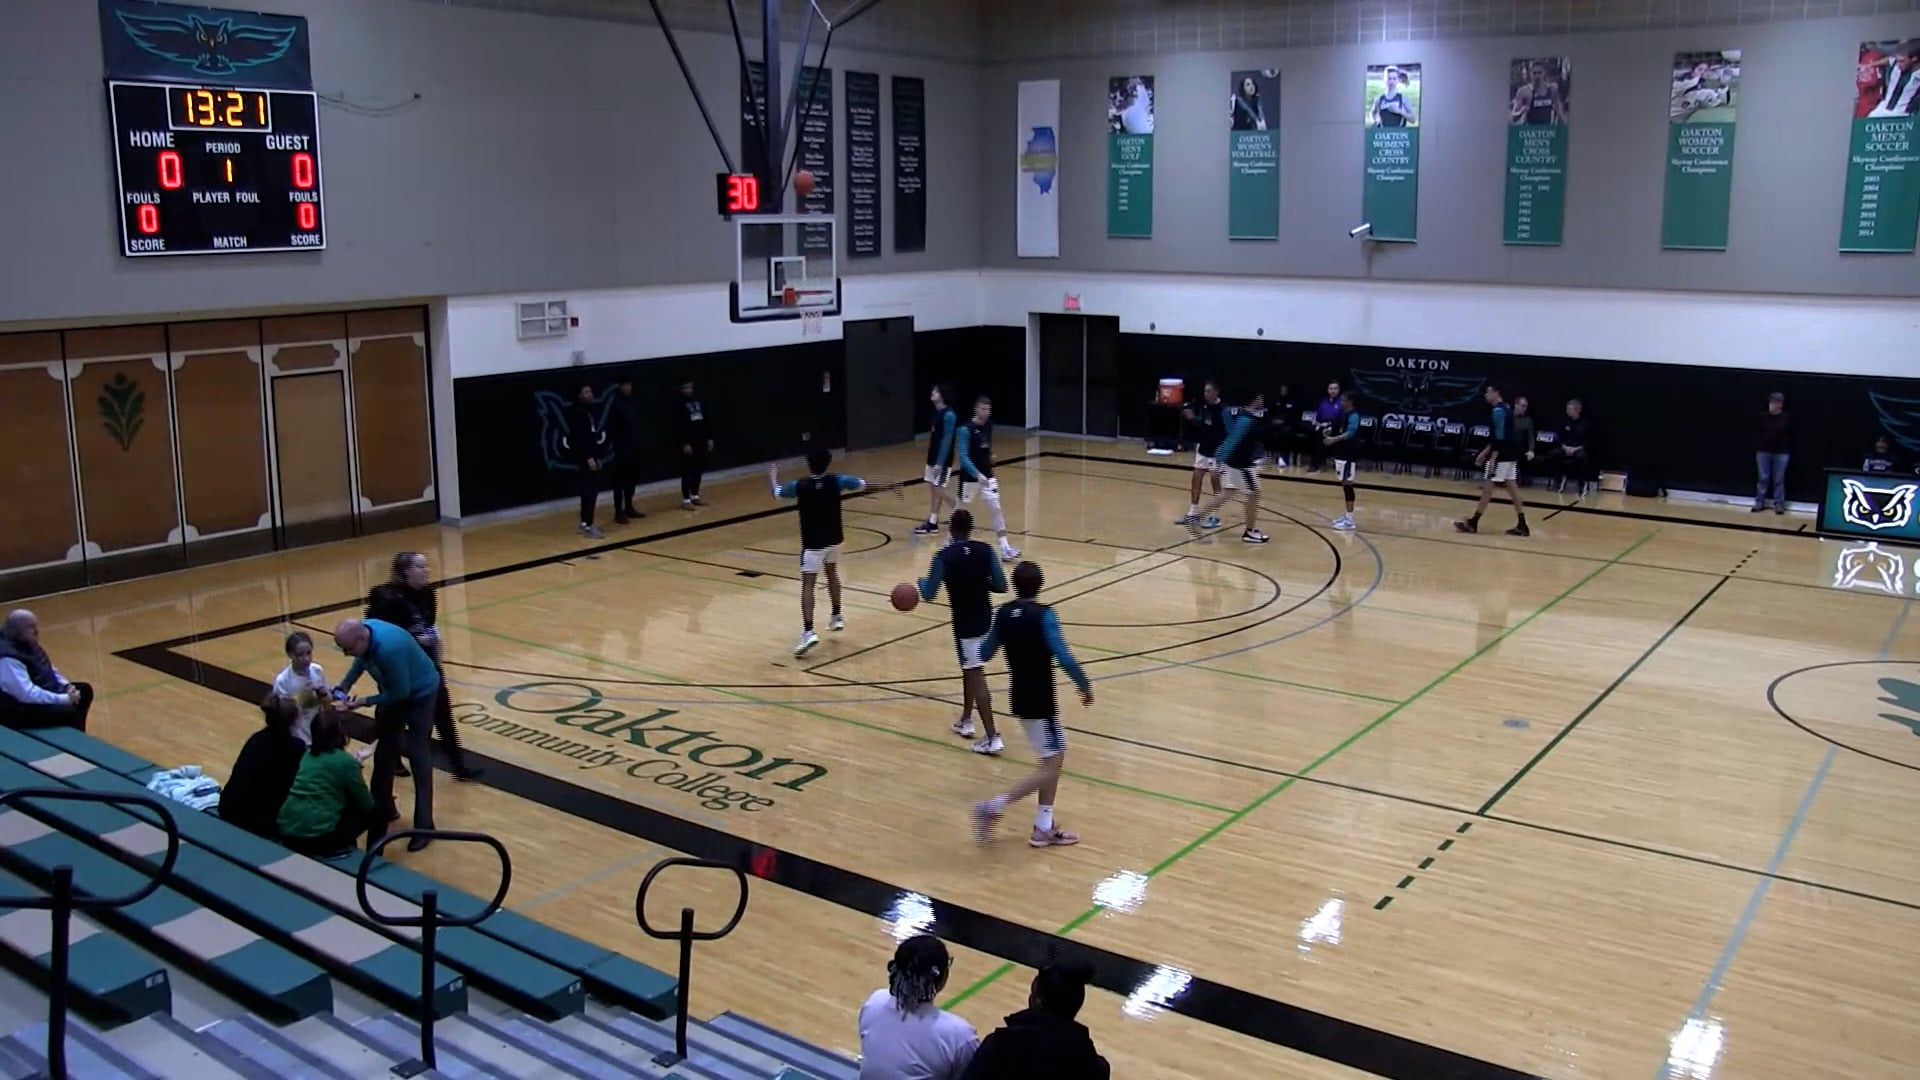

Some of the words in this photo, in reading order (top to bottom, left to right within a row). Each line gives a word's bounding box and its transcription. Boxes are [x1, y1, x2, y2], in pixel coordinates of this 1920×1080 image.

[185, 90, 265, 126] 13:21
[1681, 128, 1722, 137] OAKTON
[1865, 121, 1914, 132] OAKTON
[129, 131, 175, 148] HOME
[1239, 135, 1270, 143] OAKTON
[1374, 132, 1409, 140] OAKTON
[1519, 130, 1556, 138] OAKTON
[1871, 132, 1906, 142] MEN'S
[265, 135, 310, 151] GUEST
[1523, 139, 1550, 147] MEN'S
[1678, 137, 1724, 145] WOMEN'S
[1865, 142, 1910, 152] SOCCER
[205, 142, 241, 154] PERIOD
[1231, 150, 1277, 158] VOLLEYBALL
[1681, 146, 1720, 155] SOCCER
[1372, 157, 1410, 165] COUNTRY
[1515, 156, 1557, 164] COUNTRY
[160, 151, 183, 188] 0
[226, 158, 233, 182] 1
[293, 153, 314, 188] 0
[126, 192, 161, 205] FOULS
[193, 192, 230, 203] PLAYER
[236, 192, 261, 203] FOUL
[289, 191, 318, 202] FOULS
[727, 176, 758, 210] 30
[139, 204, 158, 233] 0
[300, 202, 316, 229] 0
[130, 239, 166, 251] SCORE
[213, 236, 248, 249] MATCH
[290, 234, 321, 246] SCORE
[1386, 356, 1450, 371] OAKTON
[494, 681, 828, 791] Oakton
[452, 703, 630, 769] Community
[626, 759, 775, 812] College
